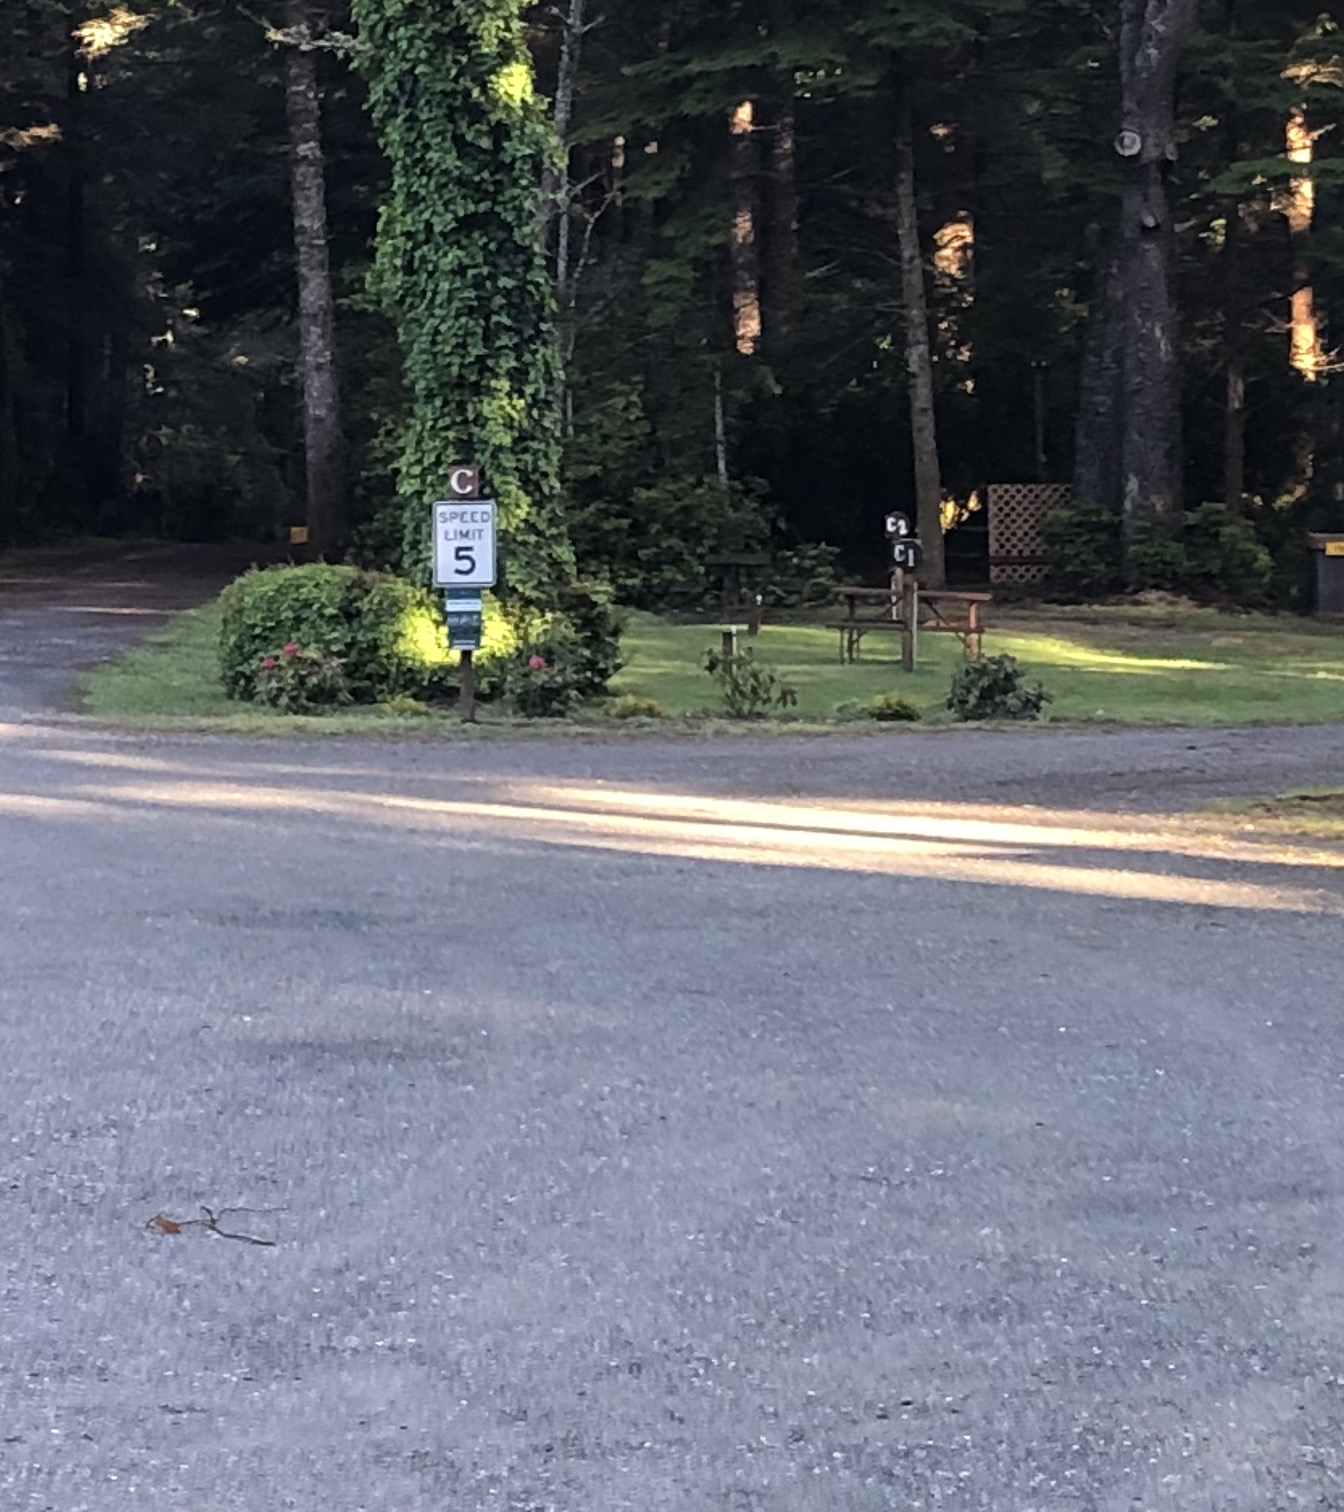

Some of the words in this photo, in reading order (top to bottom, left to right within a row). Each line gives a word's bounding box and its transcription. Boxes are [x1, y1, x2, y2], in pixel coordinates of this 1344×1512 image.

[449, 468, 475, 494] C
[438, 510, 491, 524] SPEED
[886, 517, 908, 535] C2
[443, 529, 486, 541] LIMIT
[453, 545, 477, 576] 5
[893, 544, 915, 566] C1
